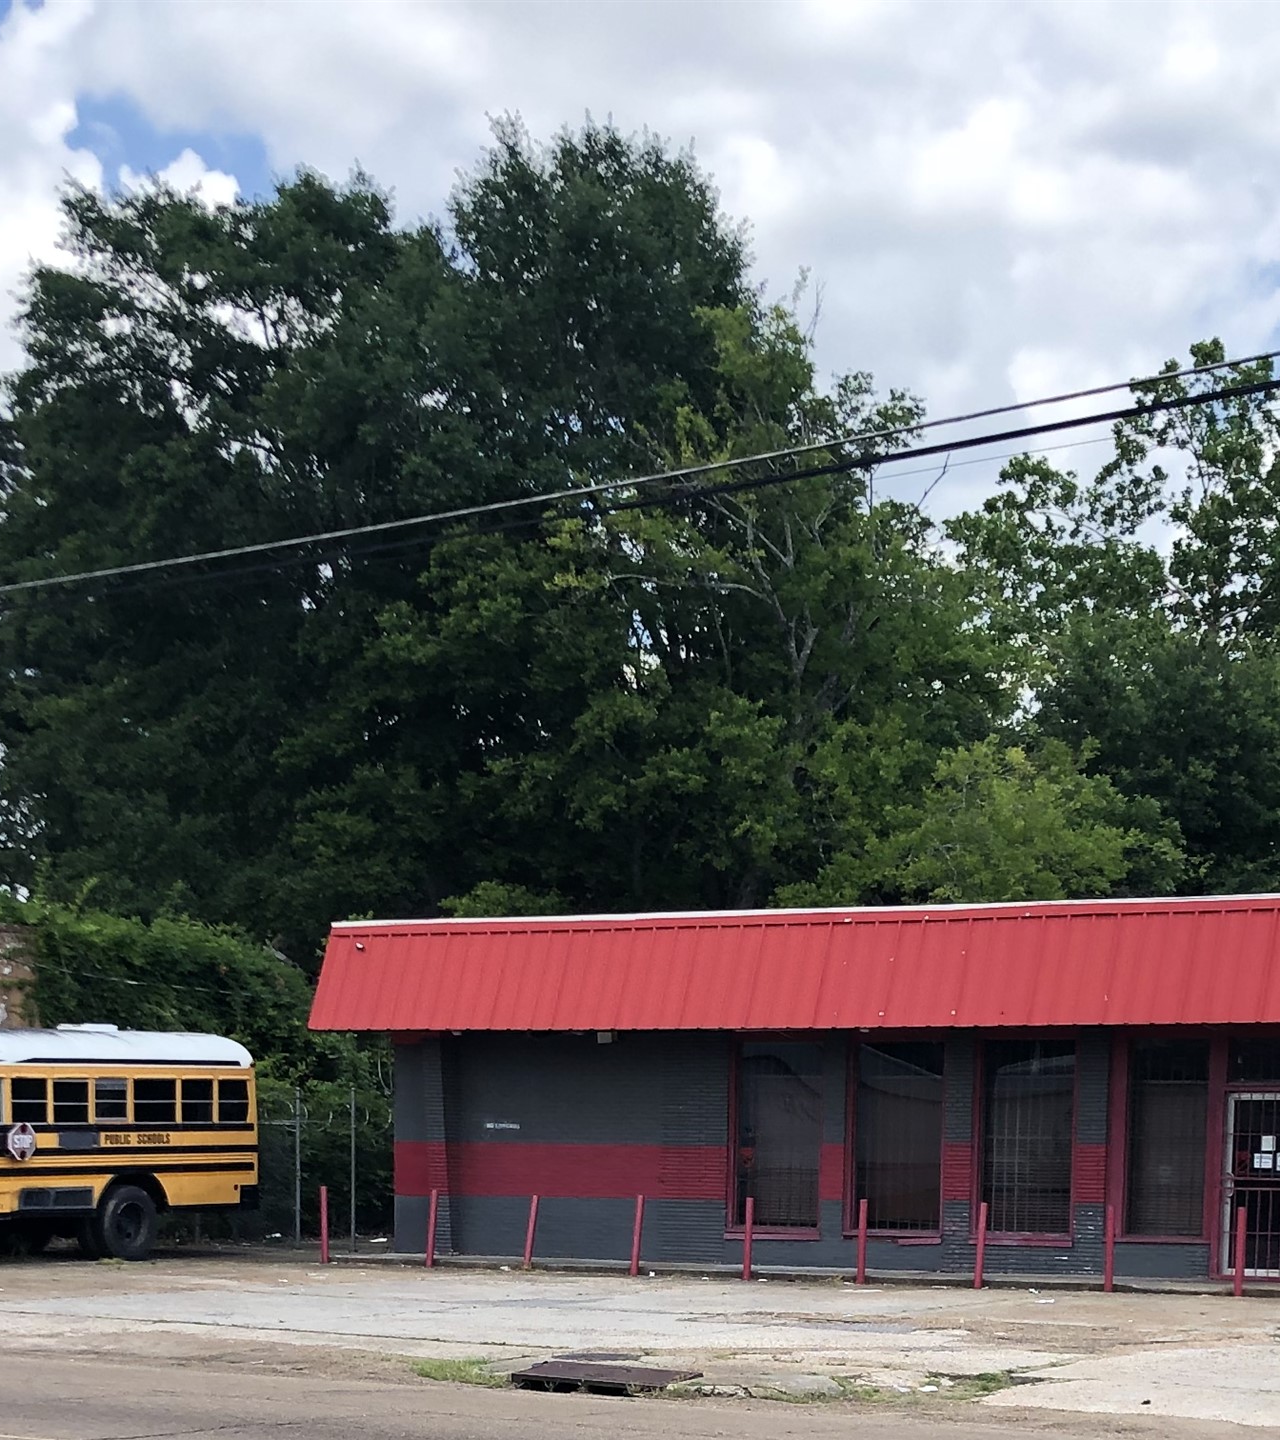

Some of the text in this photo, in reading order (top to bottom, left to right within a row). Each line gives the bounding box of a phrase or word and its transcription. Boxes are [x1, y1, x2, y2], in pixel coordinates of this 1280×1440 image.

[13, 1134, 34, 1148] STOP
[104, 1133, 171, 1145] PUBLIC SCHOOLS
